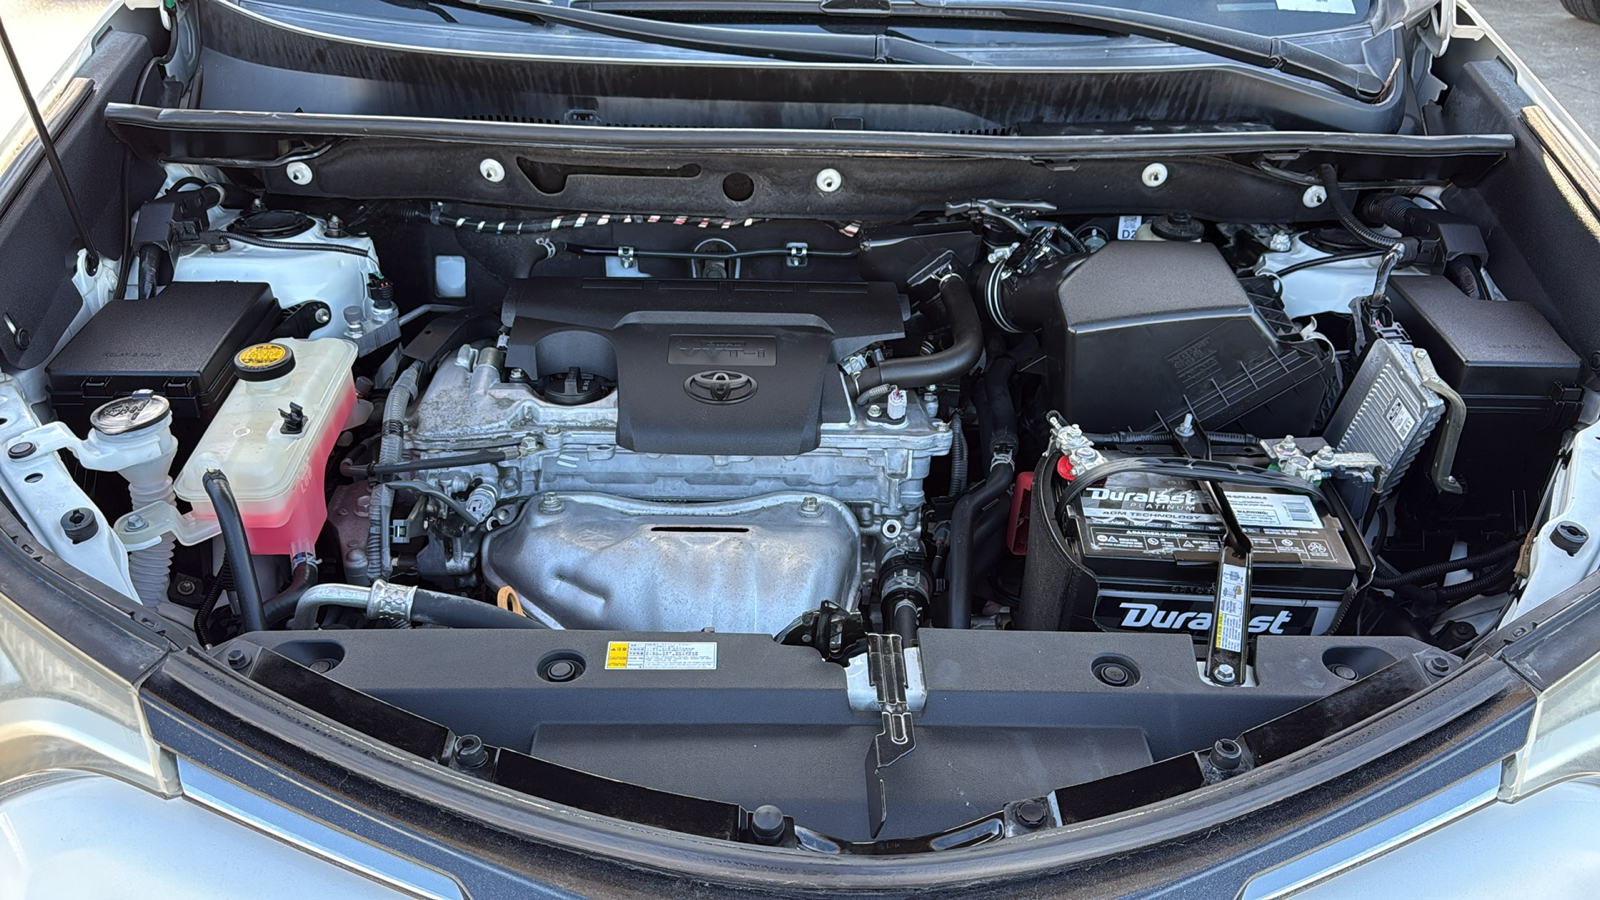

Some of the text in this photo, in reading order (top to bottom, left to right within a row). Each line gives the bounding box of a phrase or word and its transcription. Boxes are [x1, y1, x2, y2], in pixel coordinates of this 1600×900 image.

[1085, 487, 1196, 505] Duralast
[1129, 503, 1196, 511] PLATINUM
[1130, 512, 1201, 520] TECHNOLOGY
